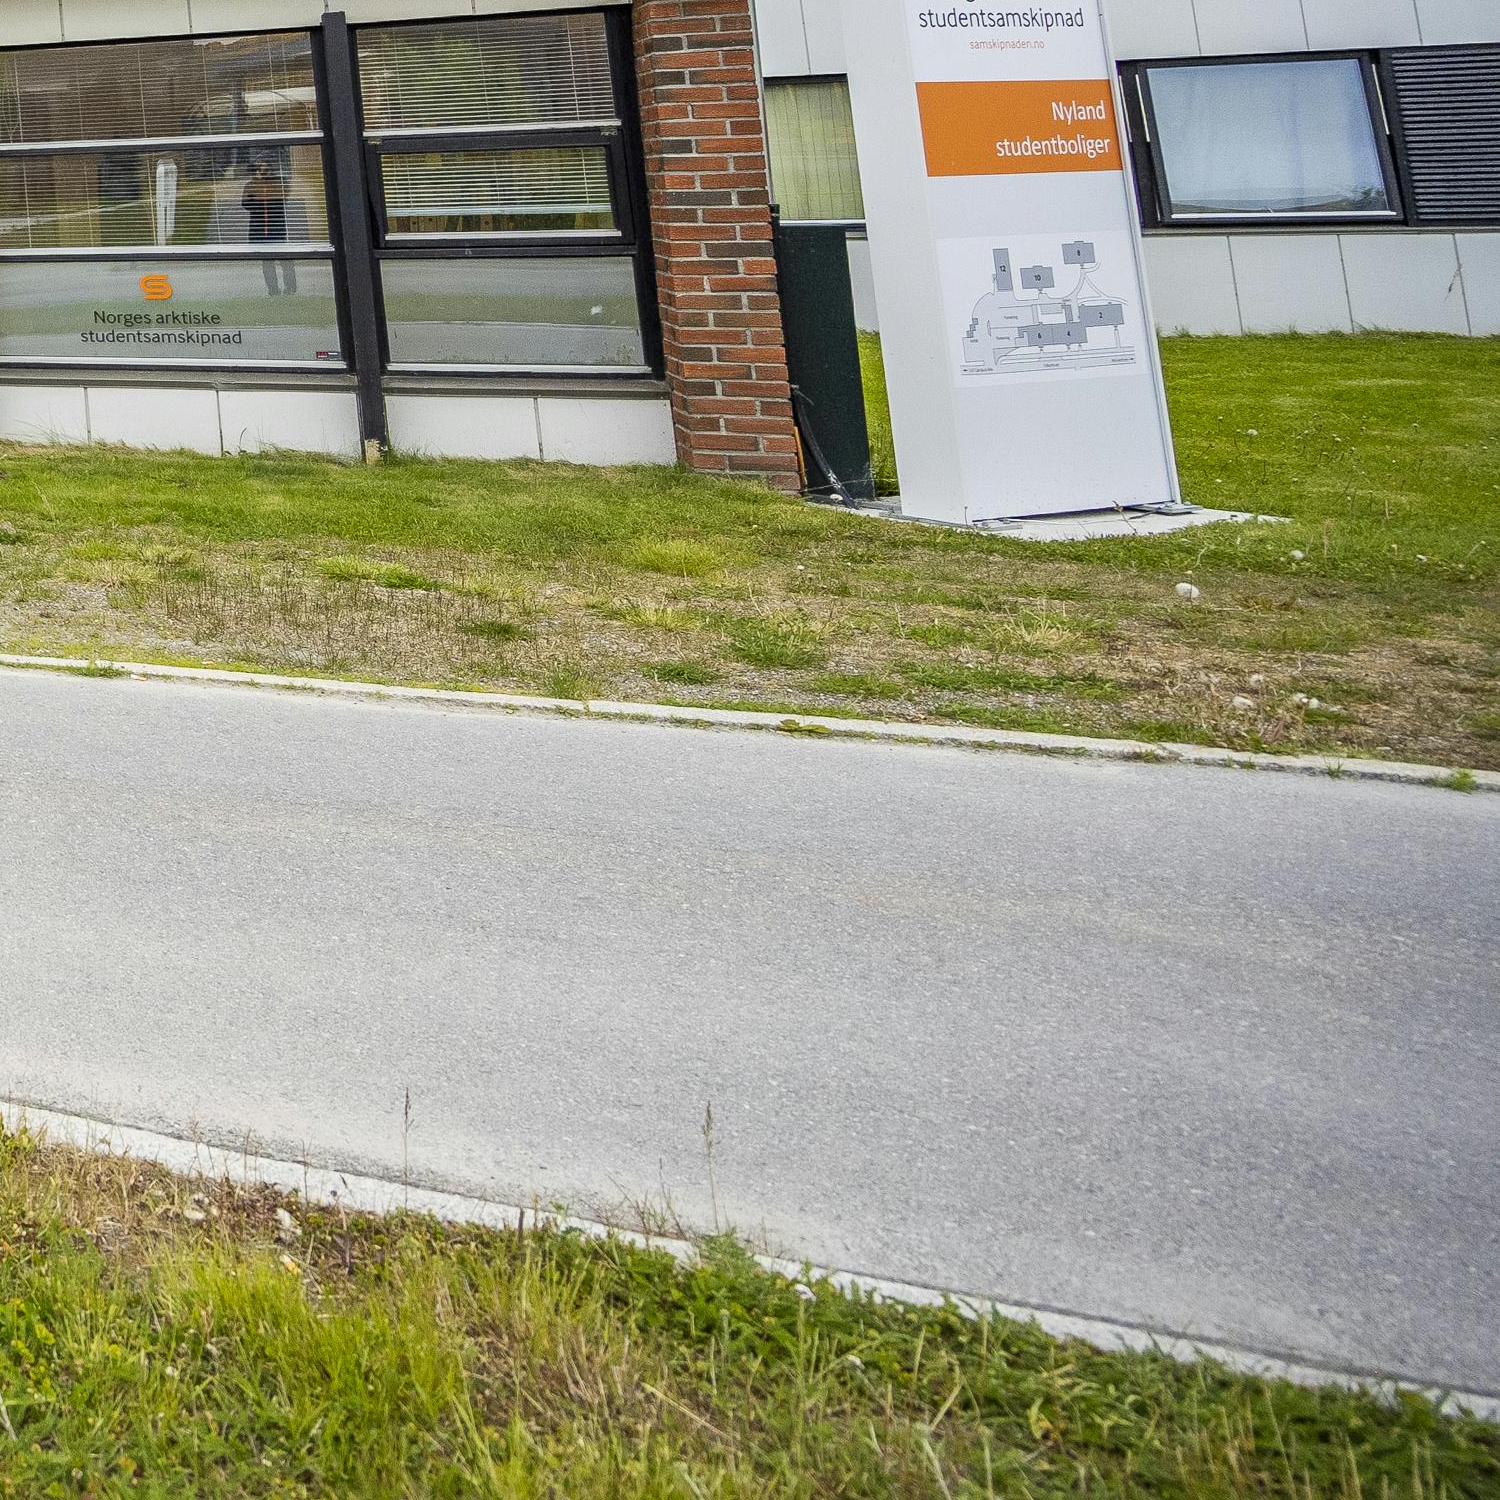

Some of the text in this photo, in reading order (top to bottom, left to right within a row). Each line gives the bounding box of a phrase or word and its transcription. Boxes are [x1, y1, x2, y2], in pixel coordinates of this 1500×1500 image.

[919, 7, 1085, 33] studentsamskipnad
[968, 38, 1045, 52] samskipnaden.no
[1051, 100, 1106, 127] Nyland
[995, 135, 1111, 159] studentboliger
[999, 264, 1006, 273] 12
[1034, 274, 1042, 282] 10
[93, 310, 221, 327] Norges arktiske
[80, 329, 243, 347] studentsamskipnad
